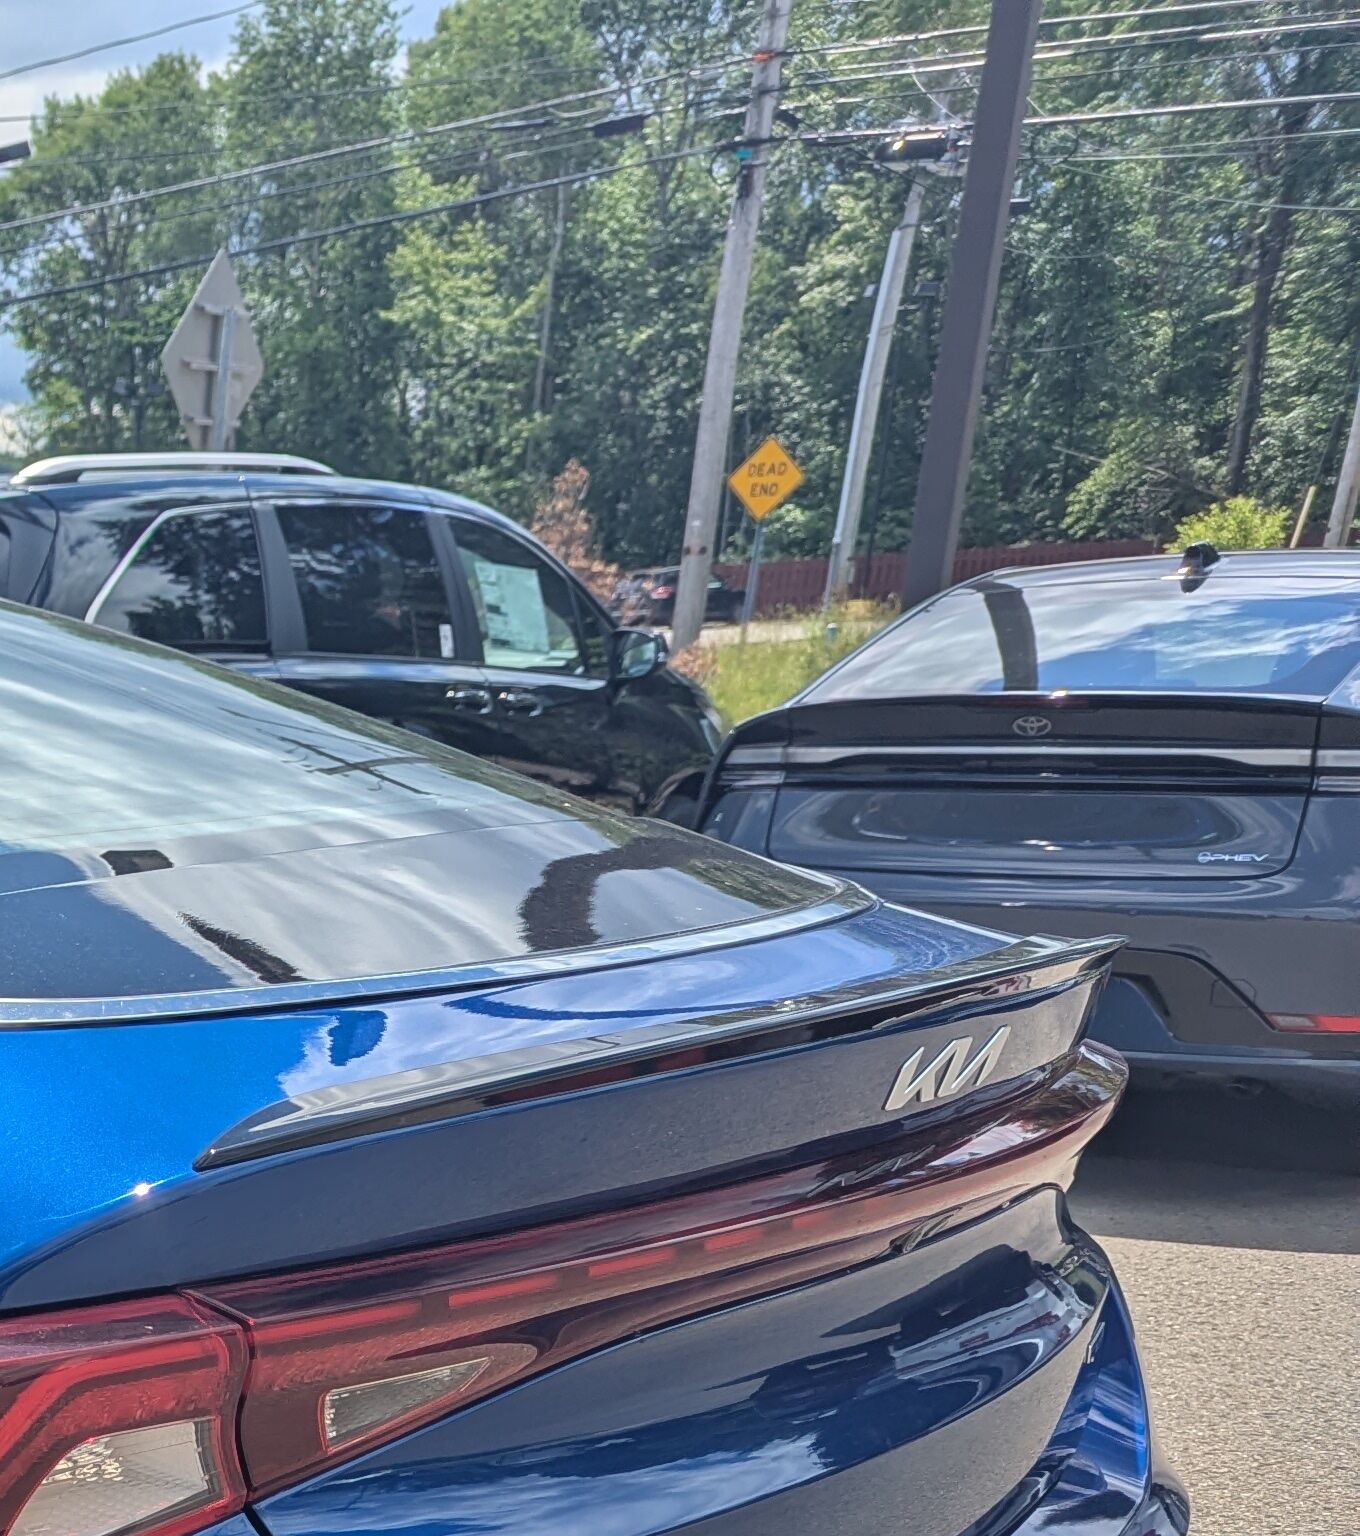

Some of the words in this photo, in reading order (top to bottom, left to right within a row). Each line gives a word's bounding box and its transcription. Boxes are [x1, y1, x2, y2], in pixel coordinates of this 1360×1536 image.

[748, 461, 787, 478] DEAD
[750, 482, 779, 498] END
[1212, 853, 1270, 862] PHEV
